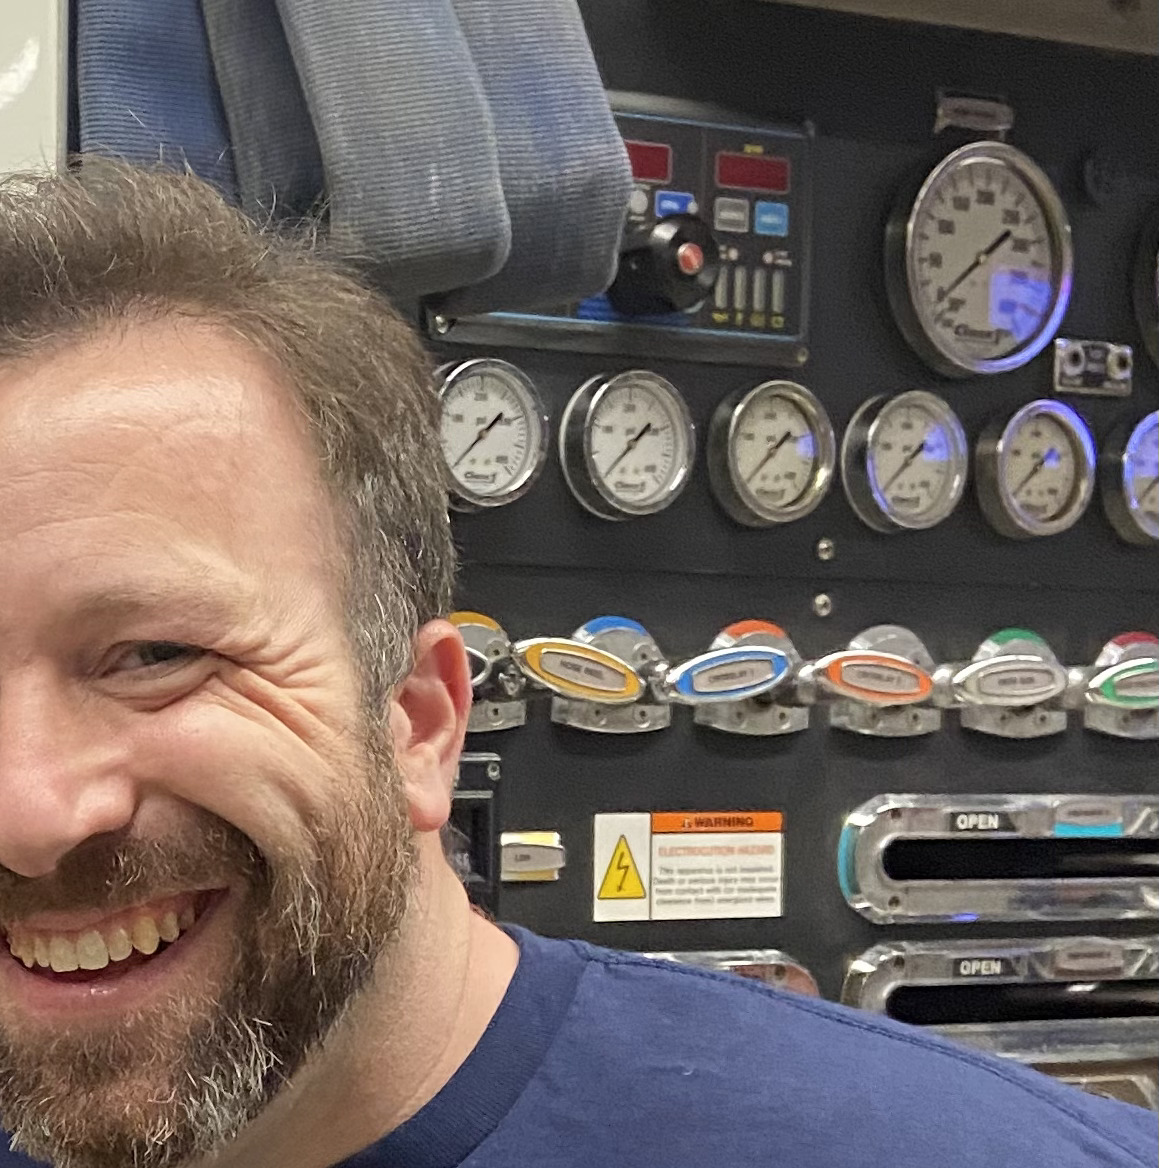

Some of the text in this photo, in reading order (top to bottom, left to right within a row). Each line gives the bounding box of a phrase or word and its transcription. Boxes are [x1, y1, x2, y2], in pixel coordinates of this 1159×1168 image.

[694, 816, 754, 828] WARNING
[956, 813, 999, 830] OPEN
[959, 959, 1002, 976] OPEN
